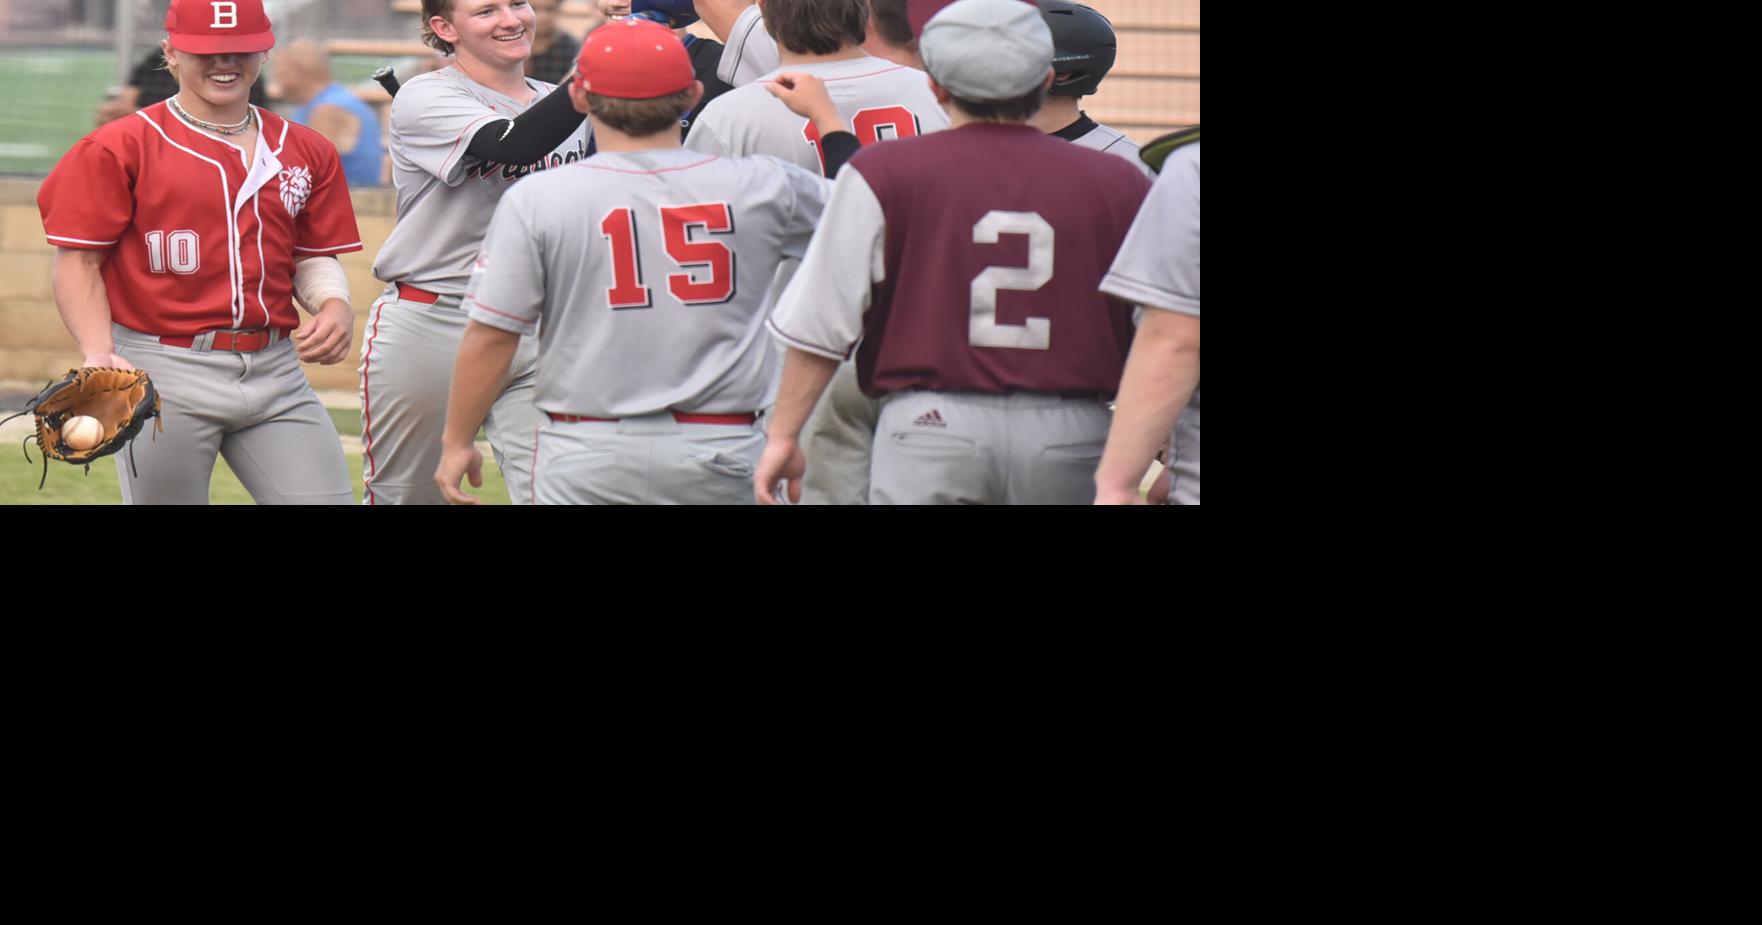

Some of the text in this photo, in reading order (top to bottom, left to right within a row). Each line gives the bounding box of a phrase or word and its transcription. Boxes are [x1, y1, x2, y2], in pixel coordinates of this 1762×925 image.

[210, 1, 237, 28] B
[144, 229, 200, 274] 10
[599, 201, 737, 310] 15
[968, 209, 1055, 350] 2
